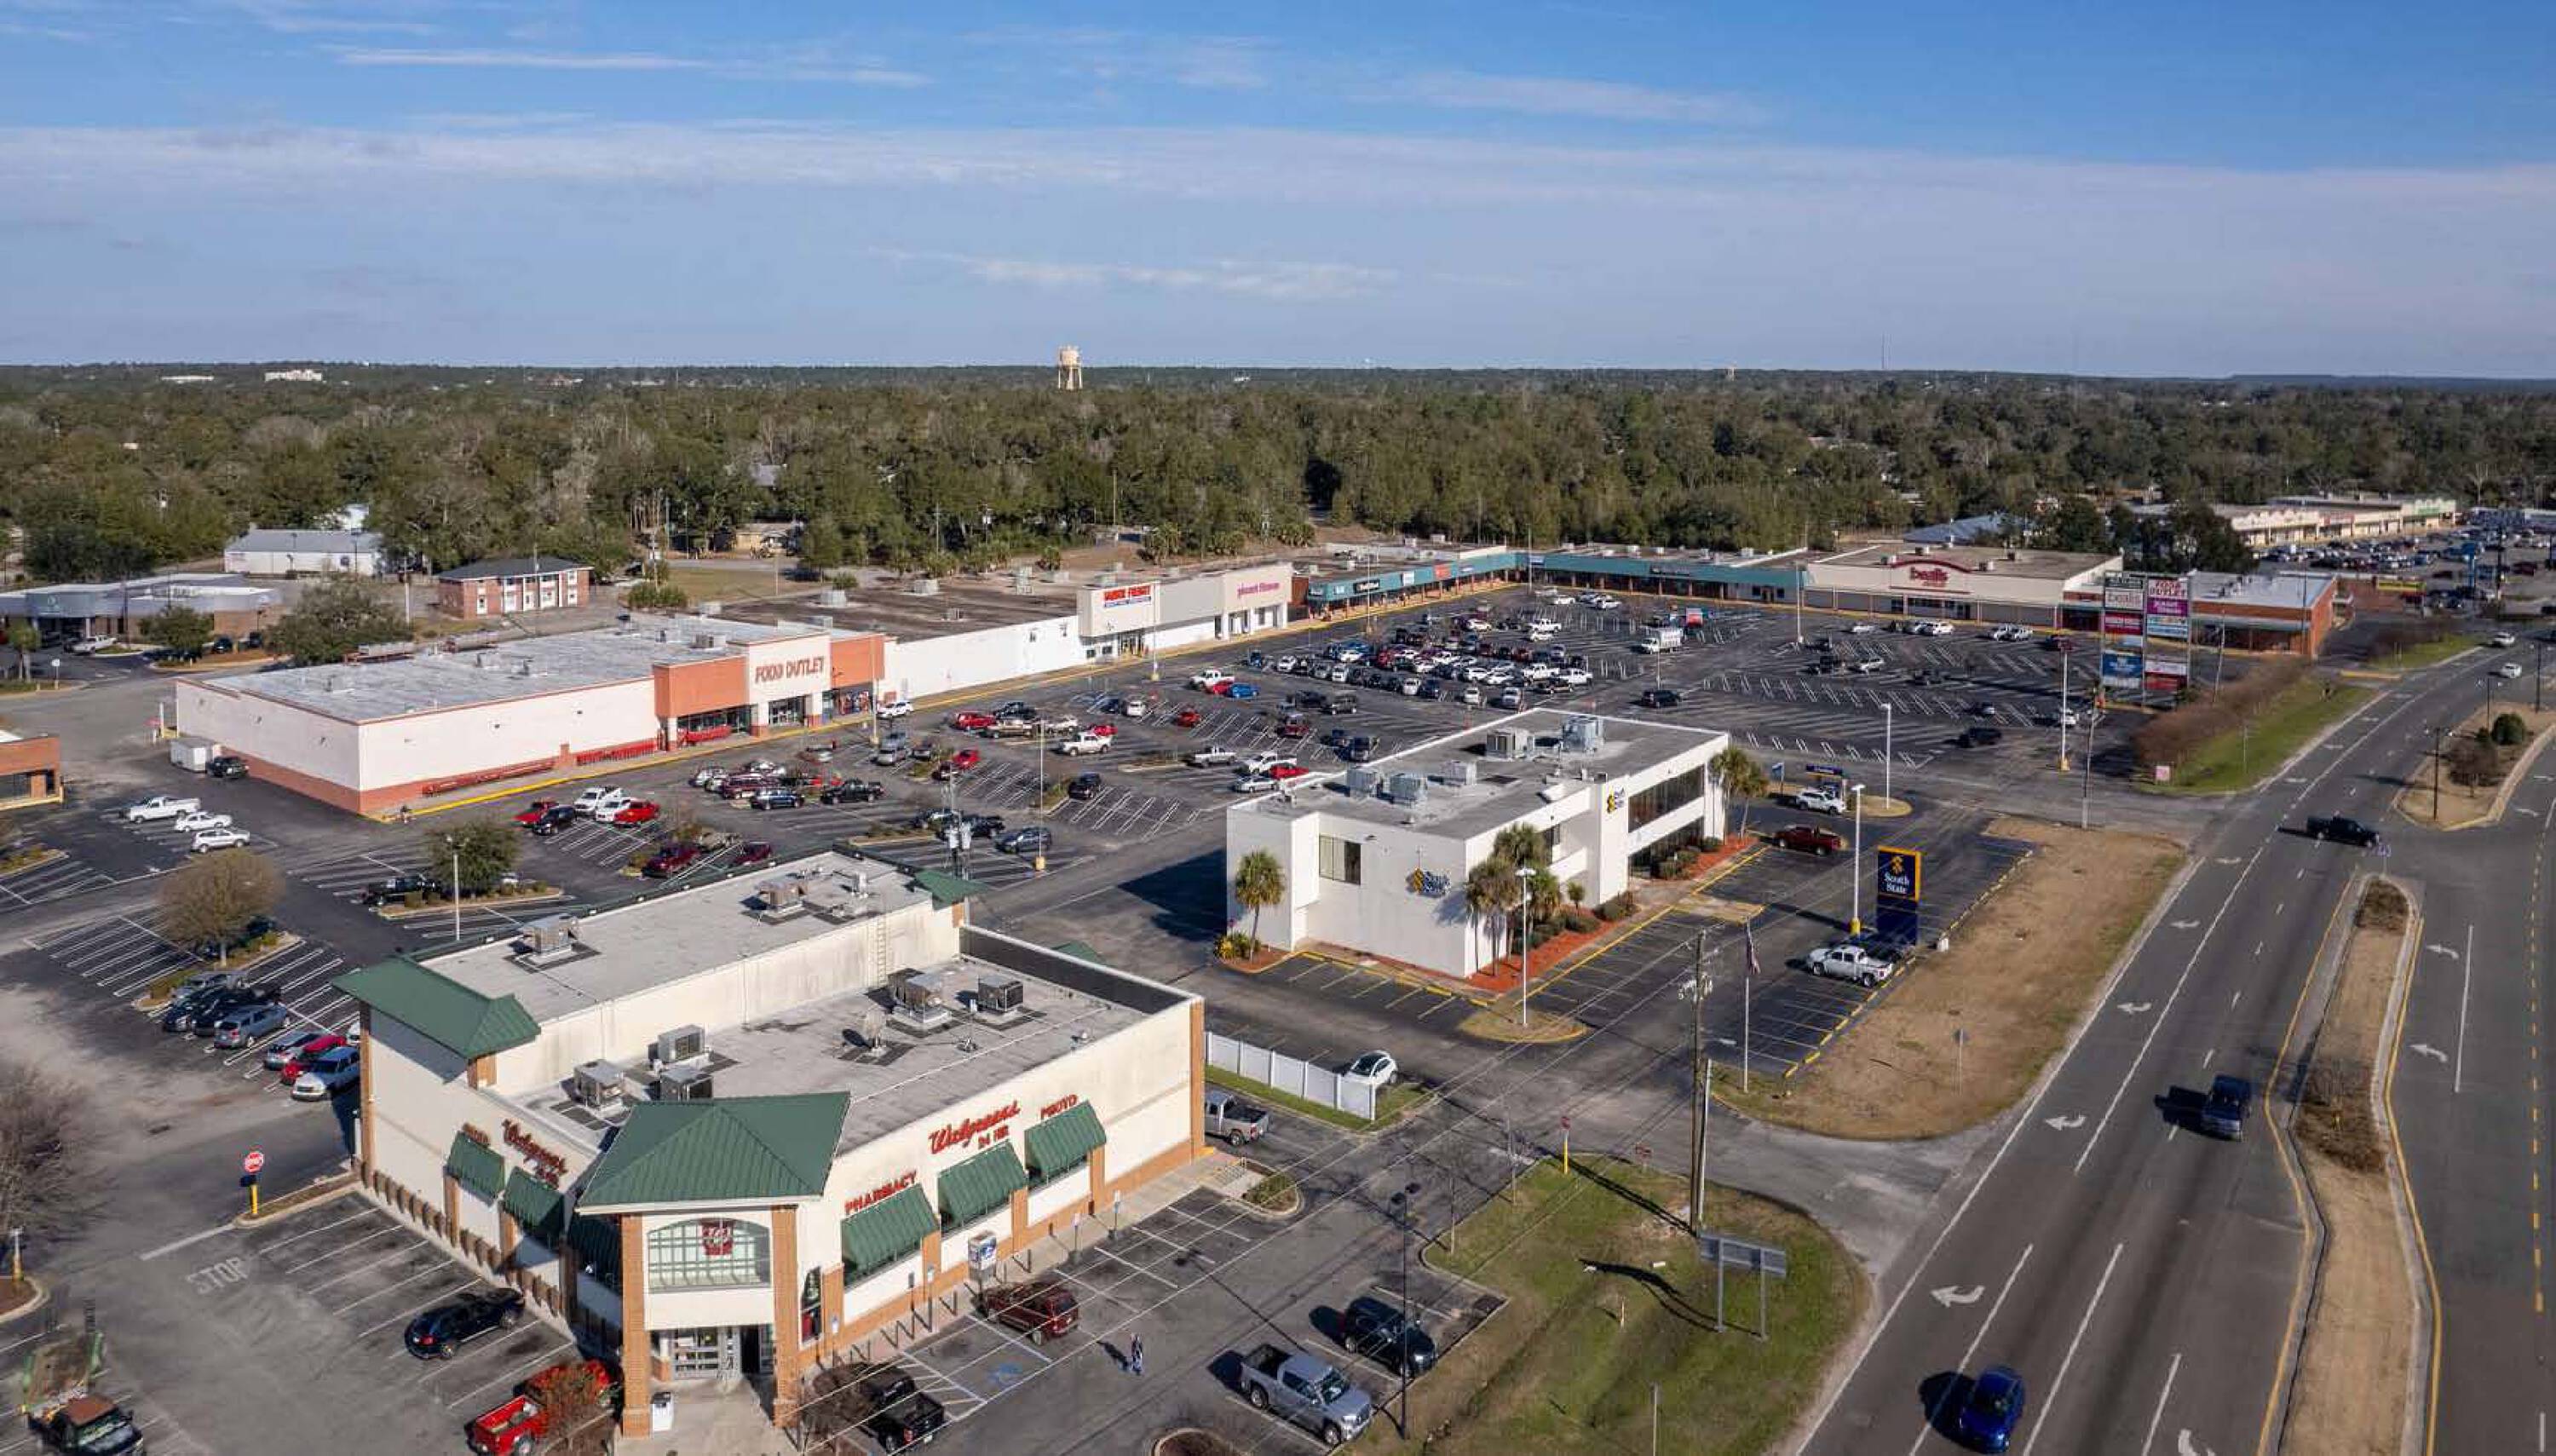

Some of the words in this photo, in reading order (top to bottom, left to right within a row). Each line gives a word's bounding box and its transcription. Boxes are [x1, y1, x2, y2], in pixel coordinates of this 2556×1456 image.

[755, 664, 783, 683] FOOD
[786, 656, 824, 678] OUTLET
[1885, 871, 1909, 885] South
[1885, 883, 1908, 895] State
[929, 1100, 1021, 1155] Walgreens
[844, 1169, 917, 1217] PHARMACY
[186, 1256, 249, 1295] STOP
